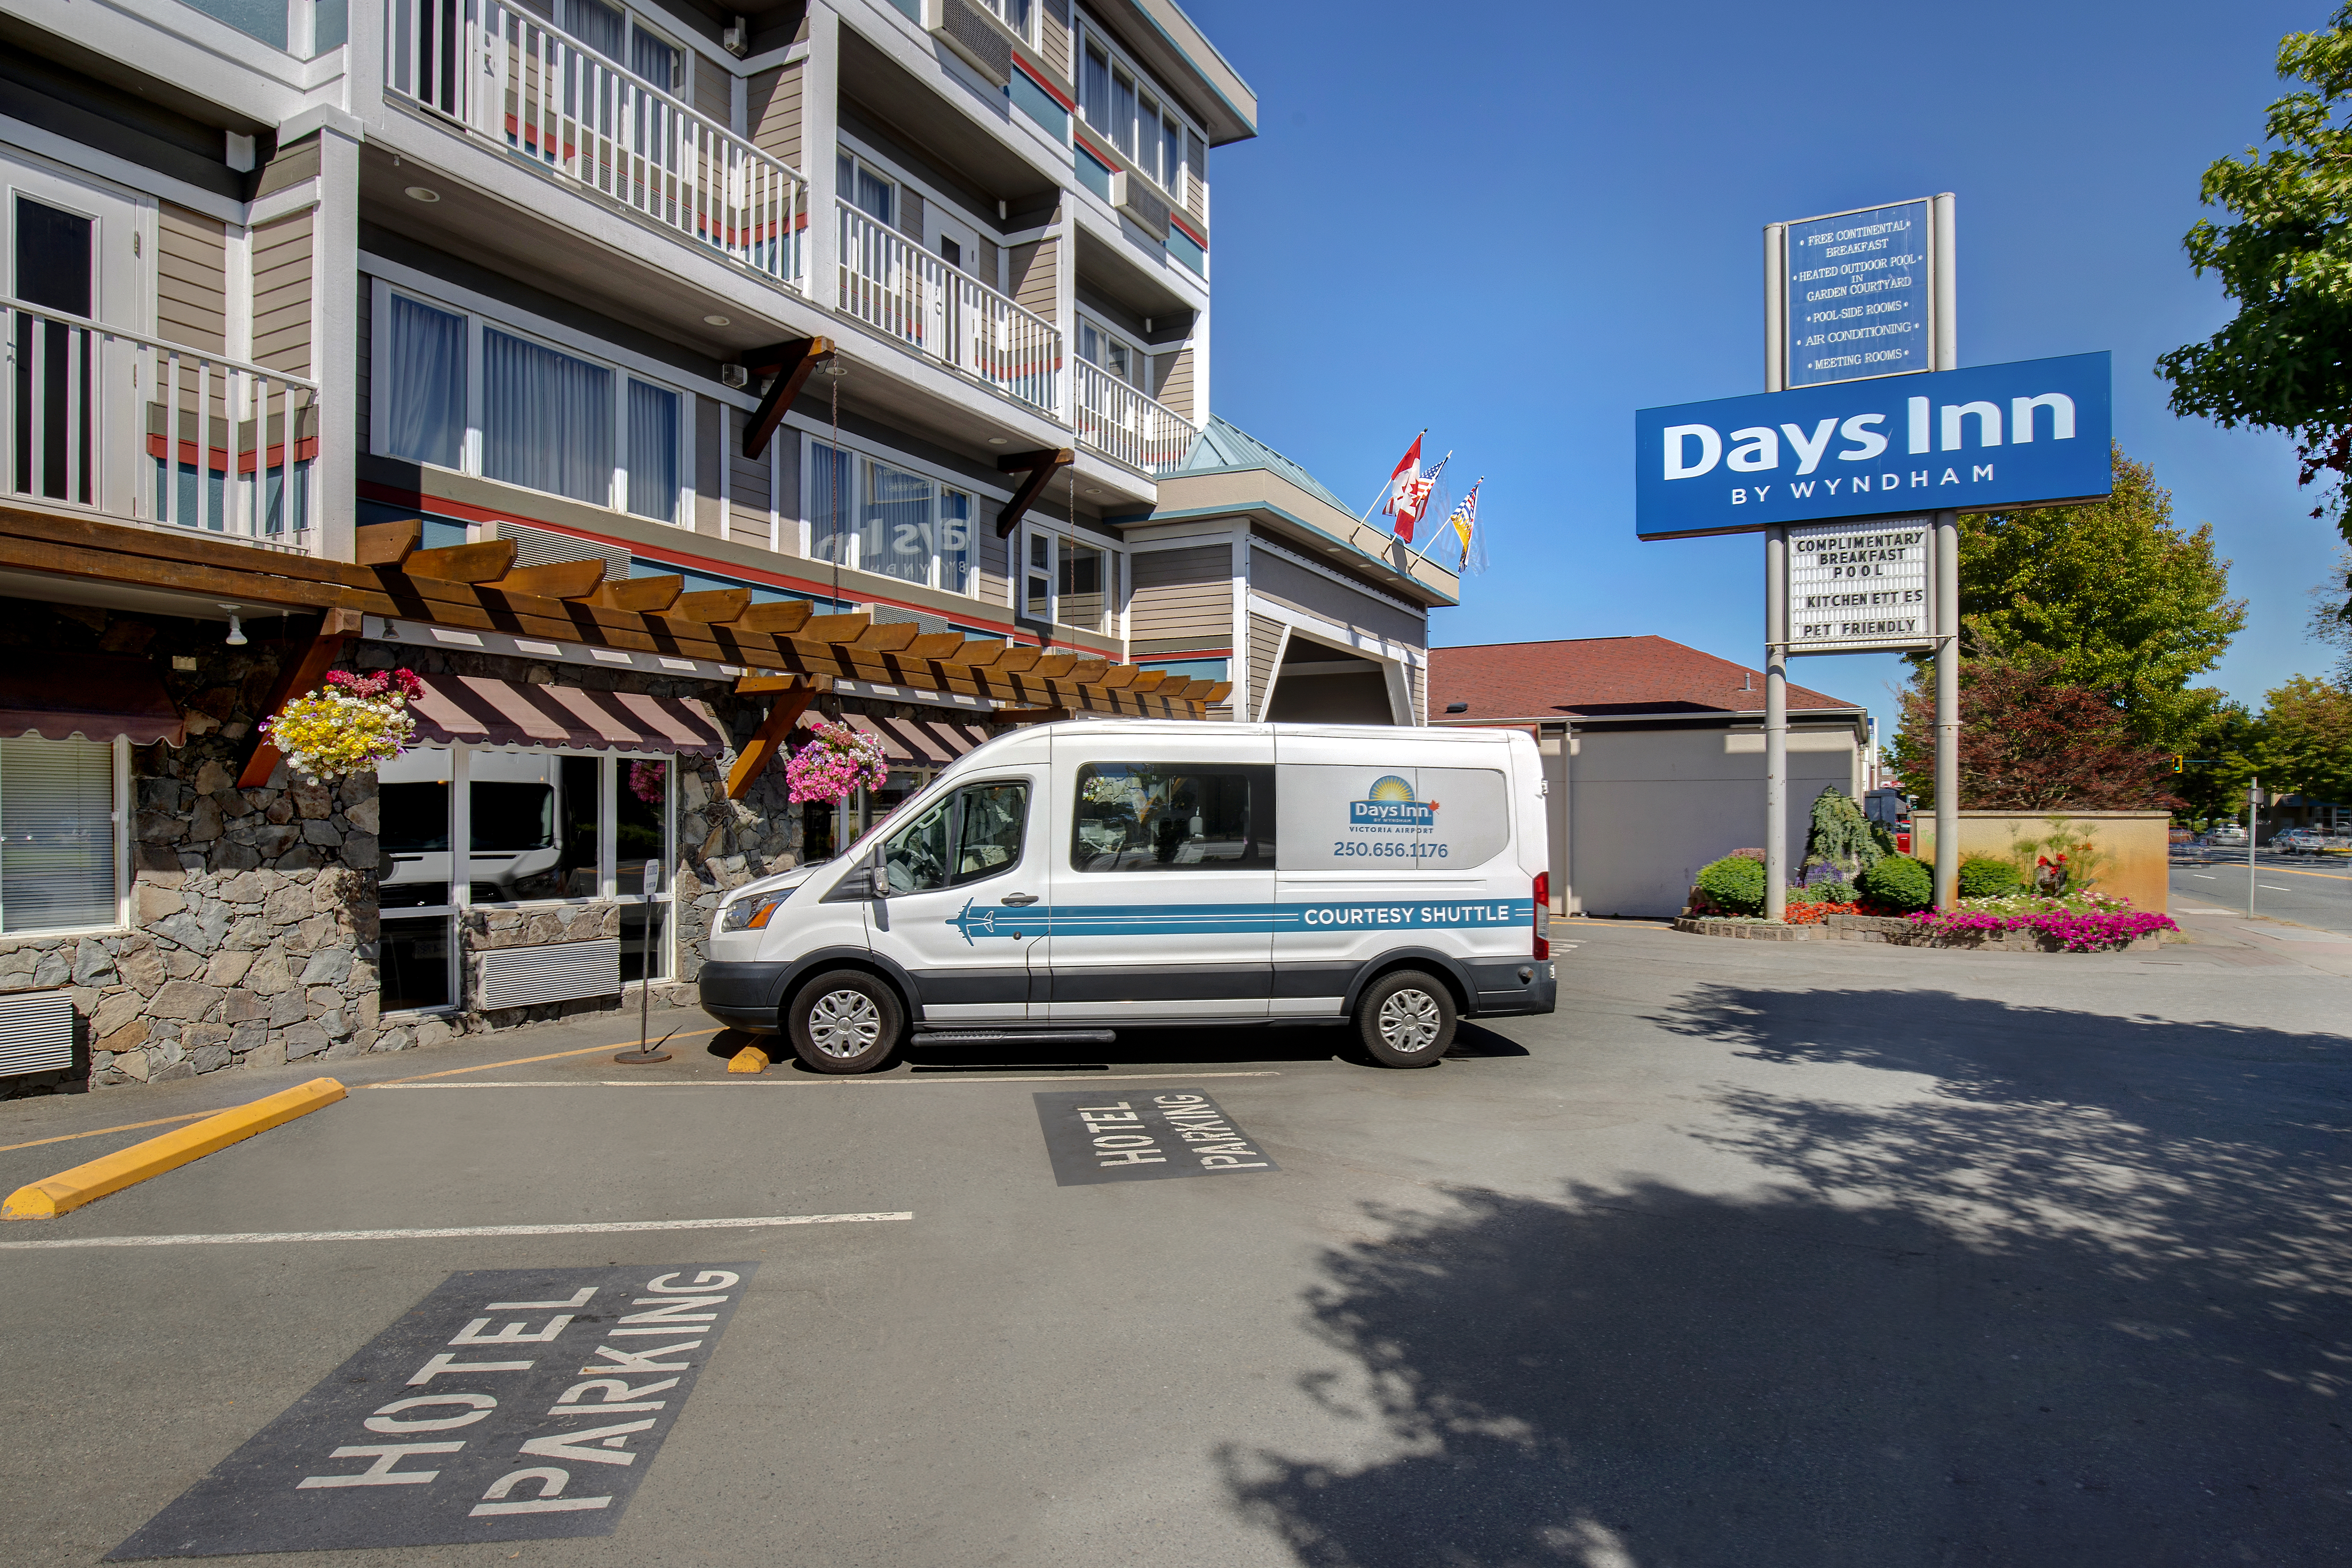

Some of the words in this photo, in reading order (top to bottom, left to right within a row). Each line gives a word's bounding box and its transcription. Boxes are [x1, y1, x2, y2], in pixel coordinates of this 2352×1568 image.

[1808, 233, 1834, 246] FREE
[1837, 220, 1906, 240] CONTINENTAL
[1826, 238, 1889, 258] BREAKFAST
[1799, 266, 1838, 282] HEATED
[1841, 259, 1887, 274] OUTDOOR
[1891, 254, 1916, 266] POOL
[1851, 274, 1864, 283] IN
[1807, 286, 1847, 301] GARDEN
[1850, 277, 1912, 294] COURTYARD
[1814, 306, 1864, 323] POOL-SIDE
[1867, 300, 1902, 314] ROOMS
[1805, 335, 1825, 346] AIR
[1828, 322, 1911, 343] CONDITIONING
[1815, 354, 1862, 370] MEETING
[1865, 349, 1902, 363] ROOMS
[1663, 413, 1889, 480] Days
[1908, 392, 2076, 455] Inn
[1732, 485, 1771, 504] BY
[1790, 464, 1994, 499] WYNDHAM
[1798, 532, 1923, 552] COMPLIMENTARY
[1820, 548, 1905, 565] BREAKFAST
[1835, 564, 1883, 578] POOL
[1805, 625, 1831, 636] PET
[1842, 620, 1915, 634] FRIENDLY
[1355, 803, 1398, 818] Days
[1400, 804, 1428, 817] Inn
[1334, 841, 1448, 858] 250.656.1176
[1305, 907, 1415, 925] COURTESY
[1421, 905, 1510, 923] SHUTTLE
[1077, 1102, 1167, 1167] HOTEL
[1153, 1095, 1268, 1170] PARKING
[296, 1287, 599, 1488] HOTEL
[469, 1270, 740, 1516] PARKING
